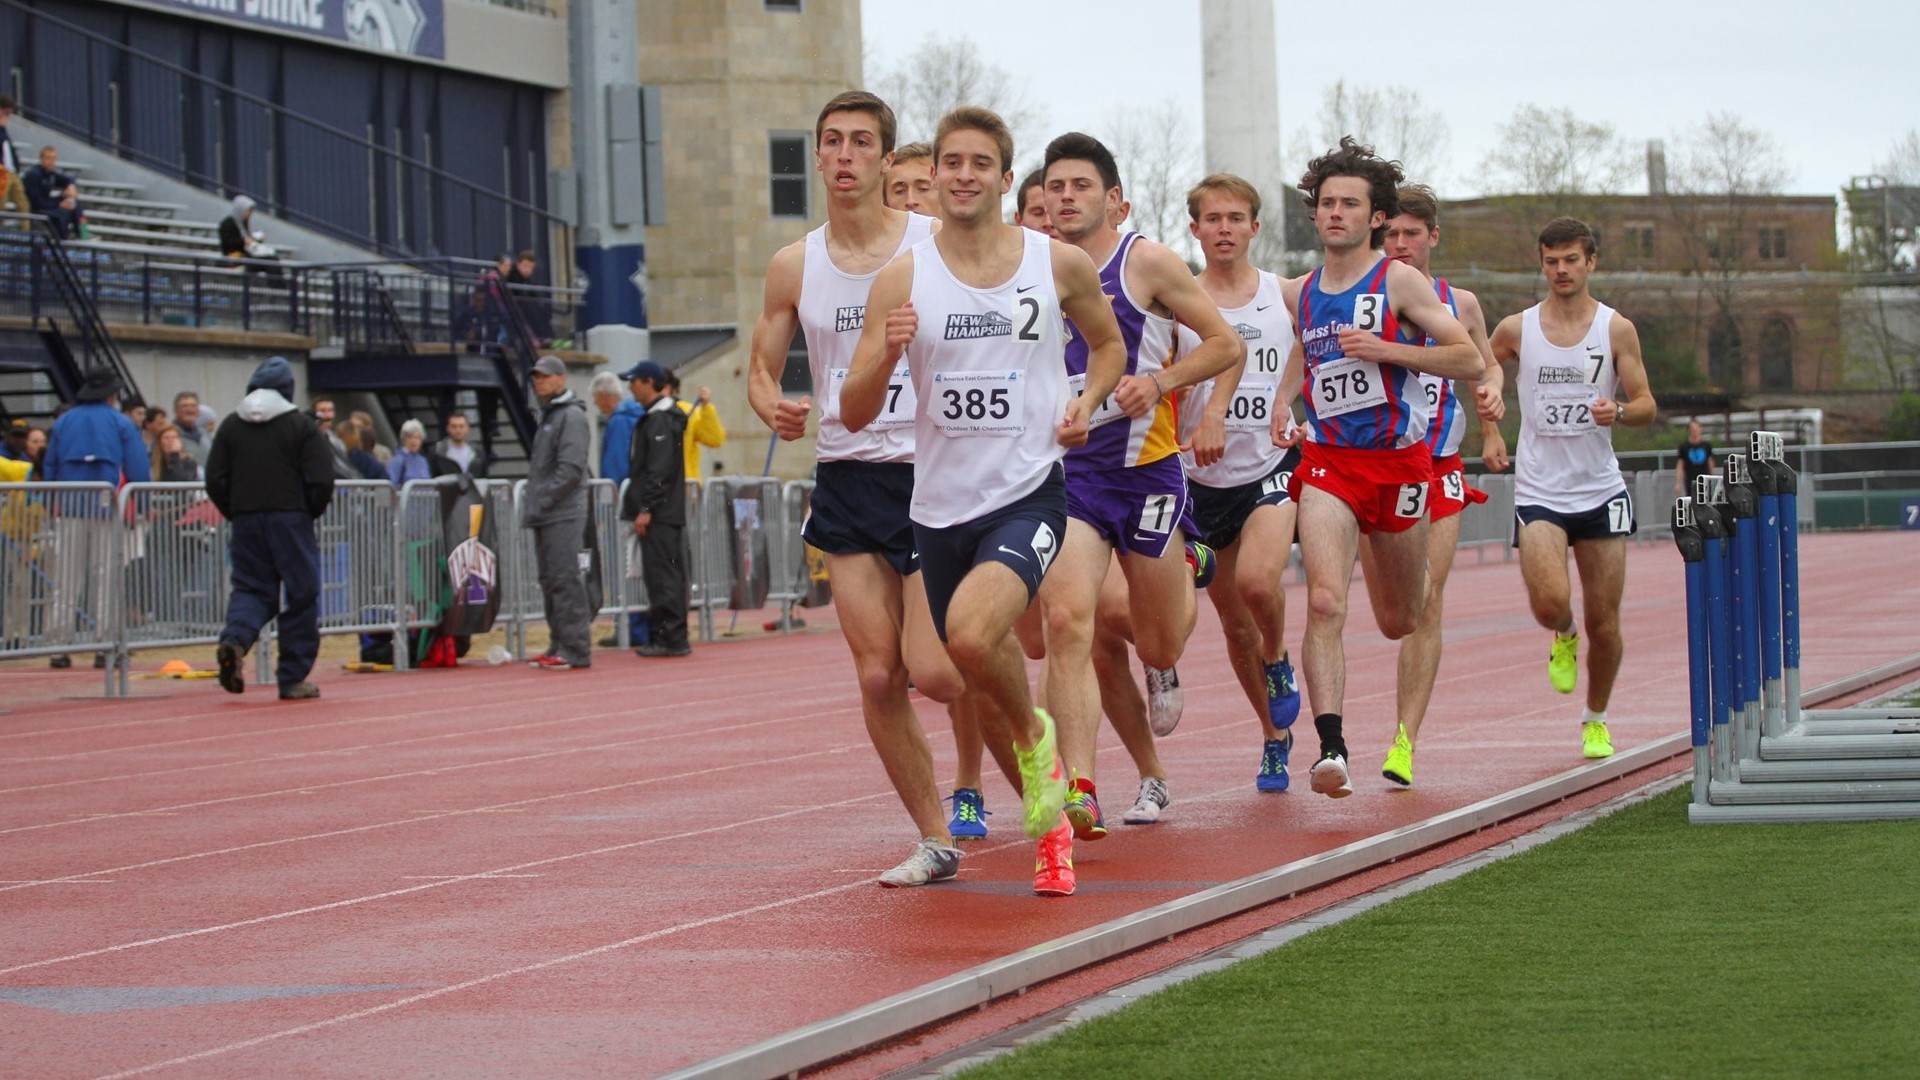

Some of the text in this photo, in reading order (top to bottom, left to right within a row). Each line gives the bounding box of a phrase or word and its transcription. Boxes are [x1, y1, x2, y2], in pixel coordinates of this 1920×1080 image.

[838, 306, 866, 319] NEW
[949, 314, 982, 326] NEW
[1018, 297, 1040, 341] 2
[1359, 295, 1376, 330] 3
[946, 325, 1012, 339] HAMPSHIR
[1255, 347, 1278, 373] 10
[1541, 367, 1565, 376] NEW
[1590, 354, 1604, 384] 7
[1321, 369, 1370, 403] 578
[943, 388, 1010, 420] 385
[1545, 403, 1590, 425] 372
[1268, 472, 1291, 491] 10
[1447, 470, 1461, 498] 9
[1153, 495, 1169, 530] 1
[1401, 483, 1423, 516] 3
[1612, 501, 1624, 530] 7
[1906, 505, 1919, 525] 7
[1036, 529, 1054, 567] 2
